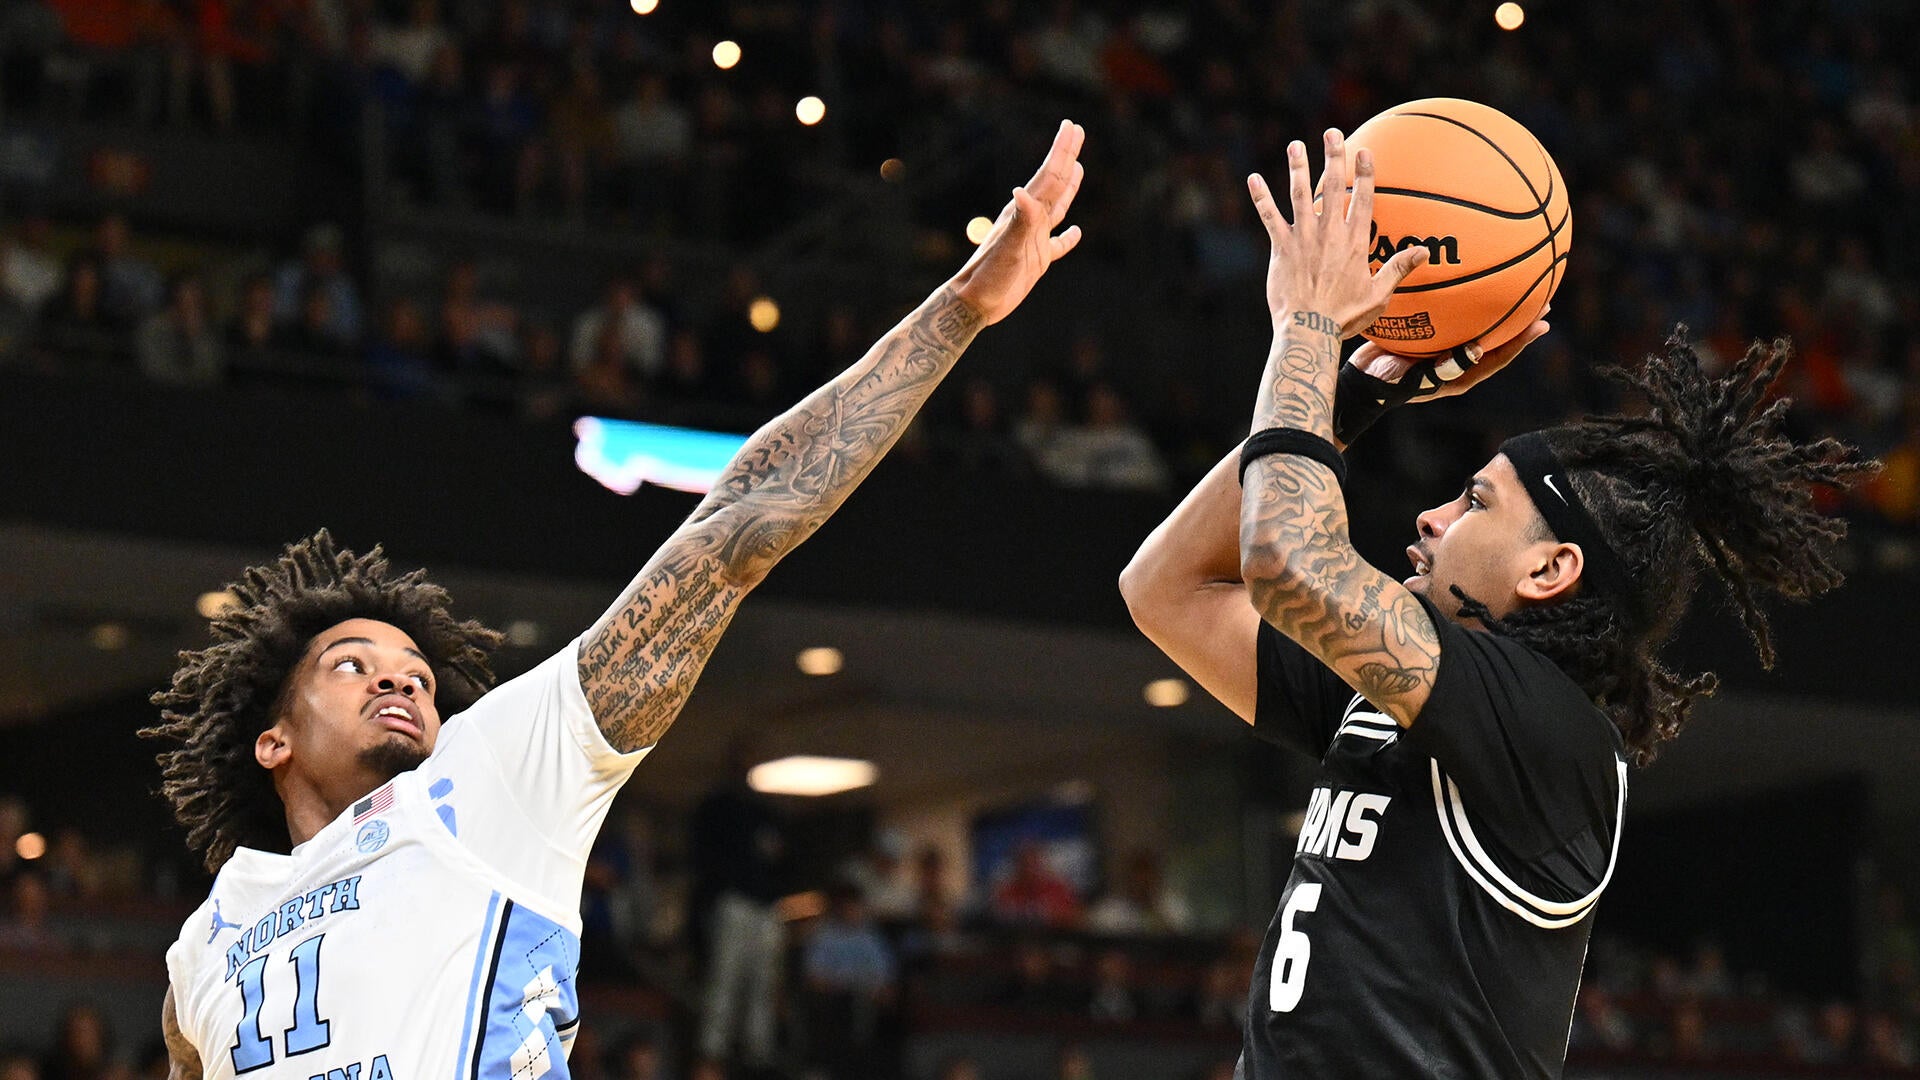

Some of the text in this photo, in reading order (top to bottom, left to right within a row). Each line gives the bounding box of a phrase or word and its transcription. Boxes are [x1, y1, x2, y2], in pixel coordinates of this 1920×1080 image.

[1368, 219, 1461, 265] lson
[1373, 318, 1406, 329] ARCH
[225, 875, 361, 983] NORTH
[1269, 882, 1323, 1012] 6
[230, 933, 330, 1076] 11
